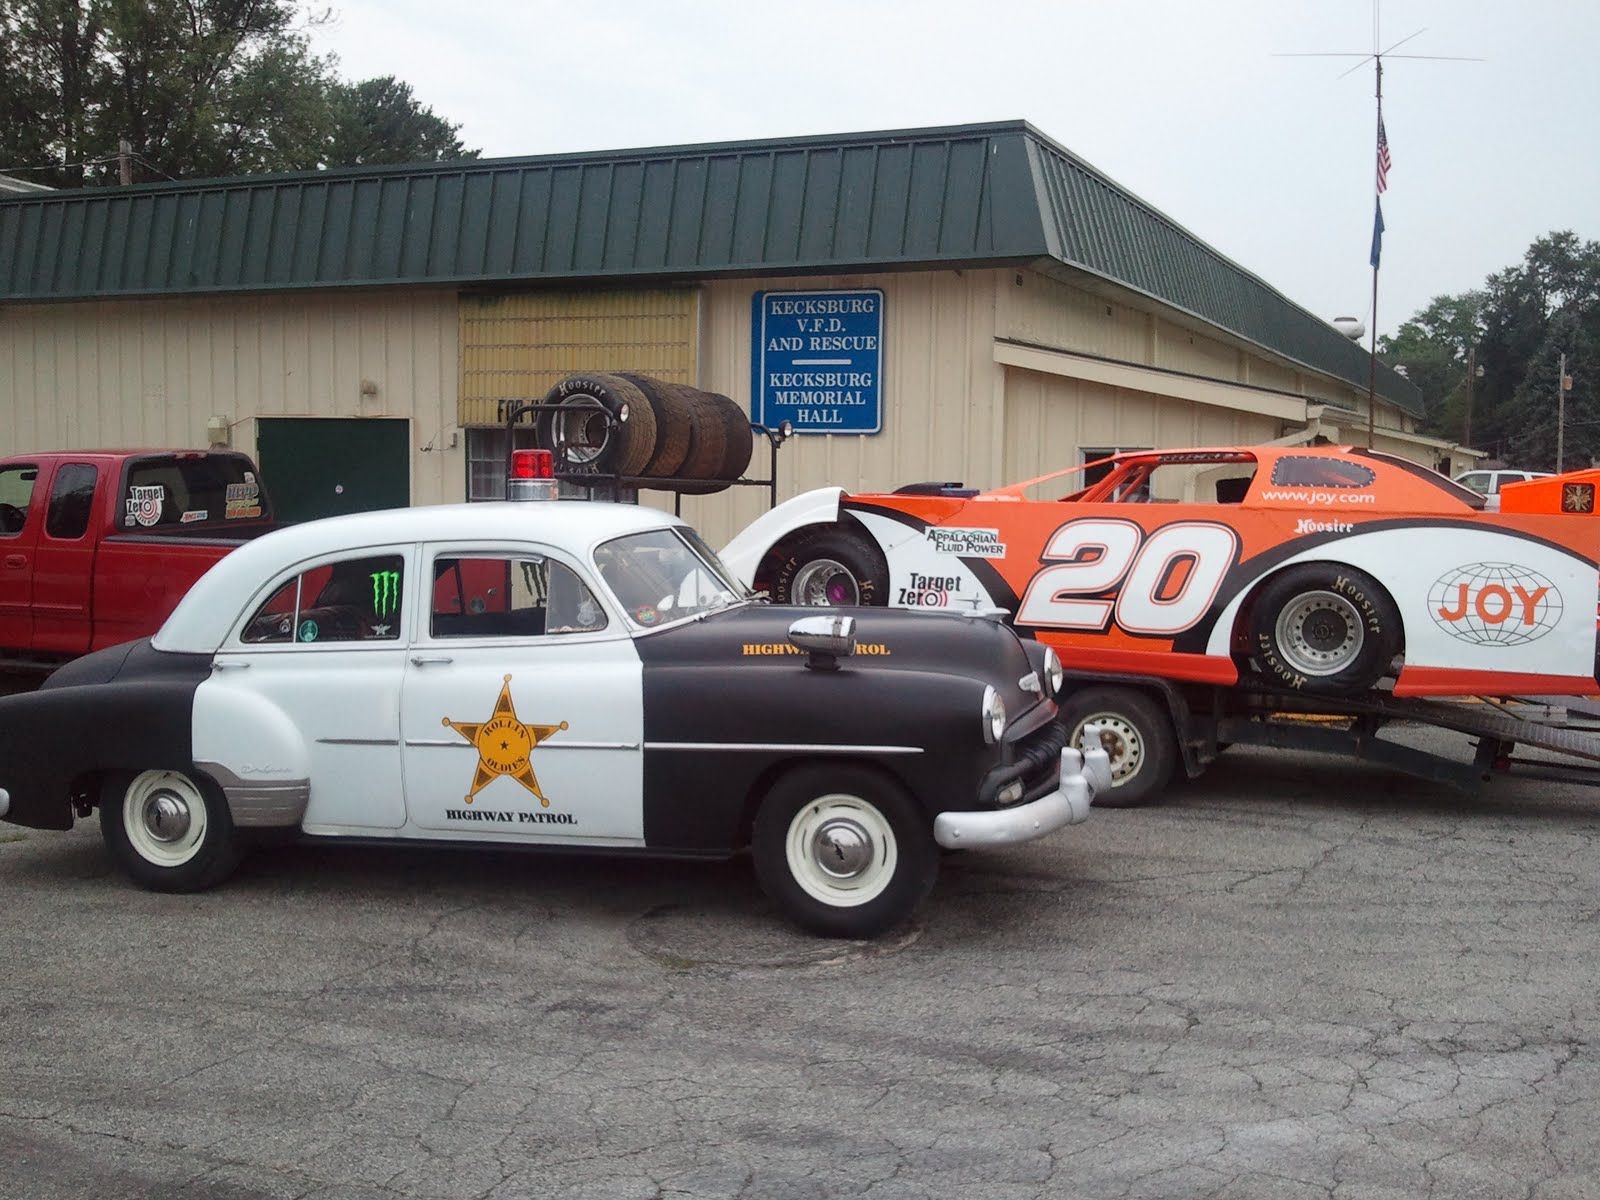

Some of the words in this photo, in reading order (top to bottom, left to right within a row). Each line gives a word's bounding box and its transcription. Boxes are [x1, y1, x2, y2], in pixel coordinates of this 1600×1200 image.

[771, 299, 875, 315] KECKSBURG
[797, 318, 846, 333] V.F.D.
[767, 338, 803, 351] AND
[809, 336, 877, 351] RESCUE
[769, 373, 872, 387] KECKSBURG
[775, 391, 866, 405] MEMORIAL
[797, 409, 843, 423] HALL
[131, 487, 164, 501] Target
[1262, 490, 1375, 505] www.joy.com
[1294, 518, 1353, 534] Hoosier
[935, 541, 964, 553] FLUID
[966, 543, 1004, 554] POWER
[777, 557, 798, 603] oosier
[910, 572, 962, 593] Target
[1013, 516, 1242, 636] 20
[898, 588, 939, 607] Zero
[1438, 583, 1549, 626] JOY
[743, 644, 809, 655] HIGHW
[484, 719, 528, 739] ROLLIN
[486, 755, 526, 772] OLDIES
[446, 809, 514, 823] HIGHWAY
[519, 812, 578, 825] PATROL
